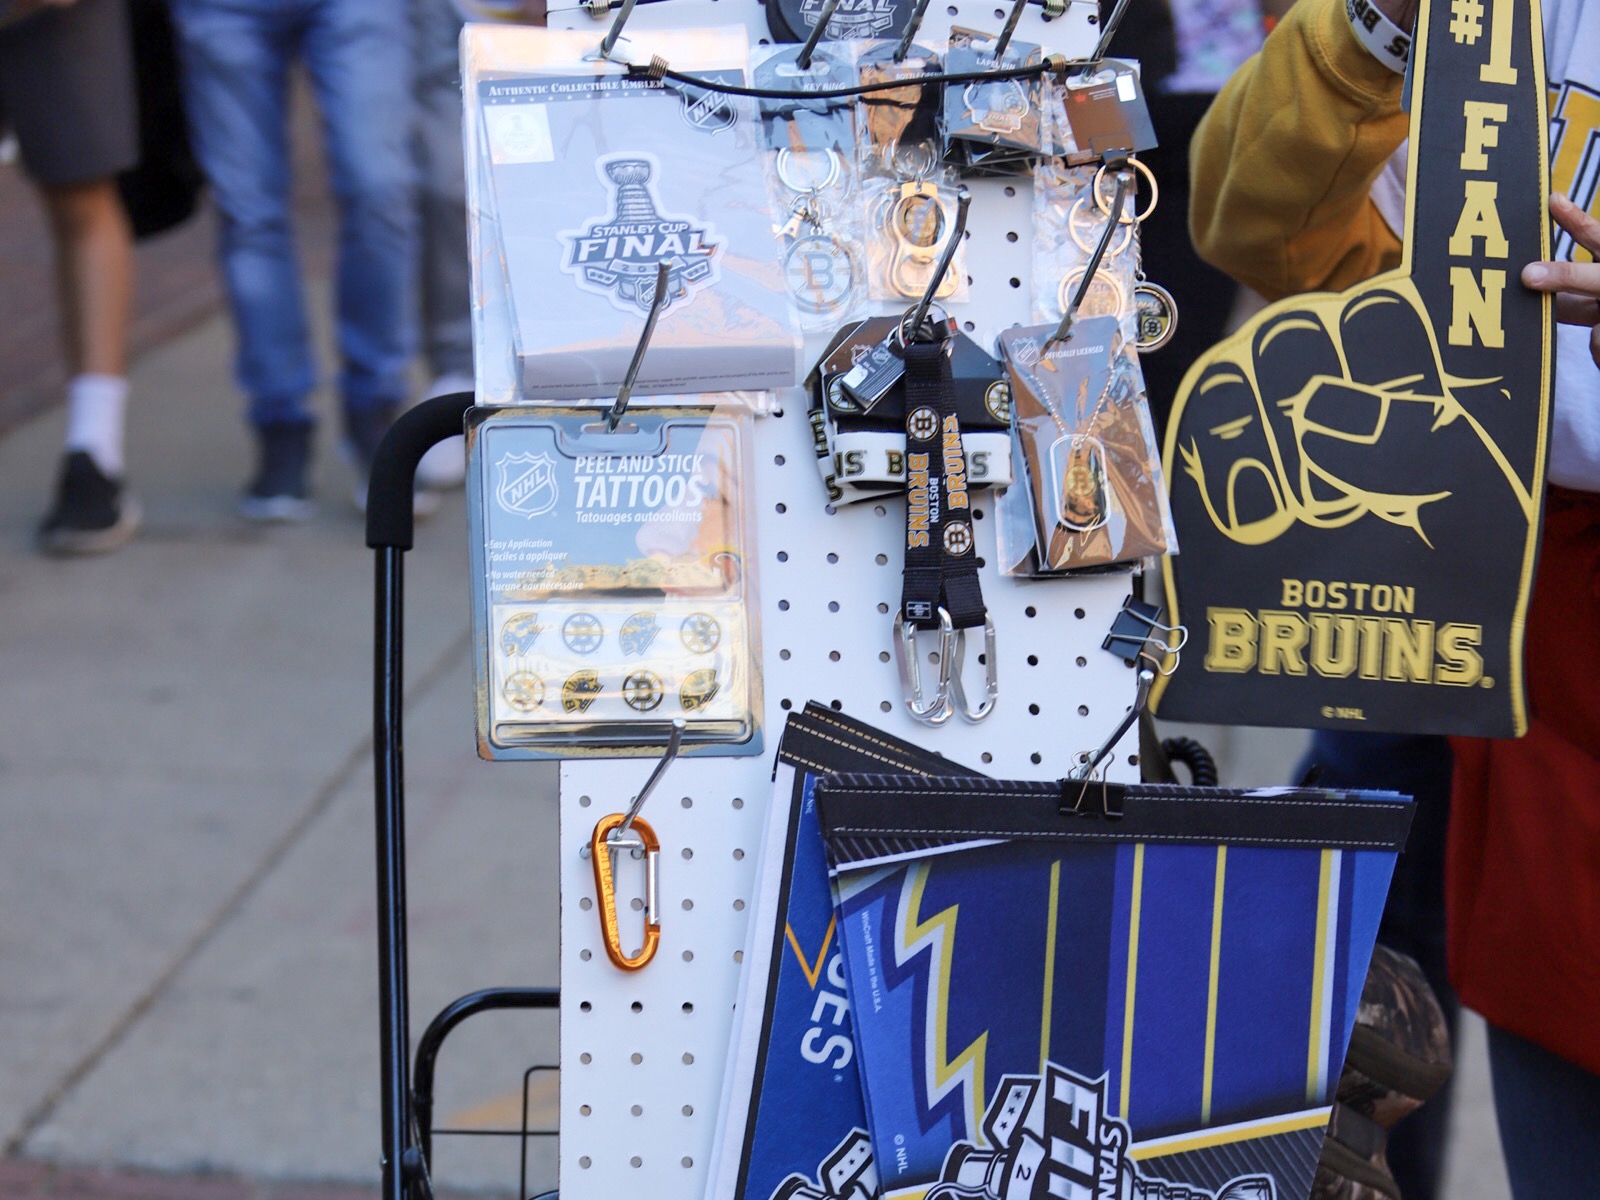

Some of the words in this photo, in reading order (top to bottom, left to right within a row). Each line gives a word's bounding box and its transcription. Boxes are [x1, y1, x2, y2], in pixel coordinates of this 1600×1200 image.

[1449, 0, 1518, 85] #1
[803, 83, 820, 92] KEY
[822, 82, 846, 91] RING
[692, 91, 726, 122] NHL
[592, 224, 656, 238] STANLEY
[658, 222, 689, 234] CUP
[1448, 101, 1510, 349] FAN
[578, 233, 714, 262] FINAL
[574, 456, 613, 474] PEEL
[616, 456, 654, 474] AND
[657, 454, 704, 473] STICK
[942, 414, 970, 511] BRUINS
[510, 469, 546, 504] NHL
[574, 474, 704, 508] TATTOOS
[906, 452, 930, 549] BRUINS
[929, 477, 939, 523] BOSTON
[576, 510, 633, 526] Tatouages
[634, 509, 703, 523] autocollants
[490, 540, 508, 550] Easy
[508, 539, 553, 550] Application
[1281, 578, 1415, 614] BOSTON
[1203, 606, 1485, 688] BRUINS
[1335, 706, 1367, 720] NHL
[896, 1148, 909, 1174] NHL
